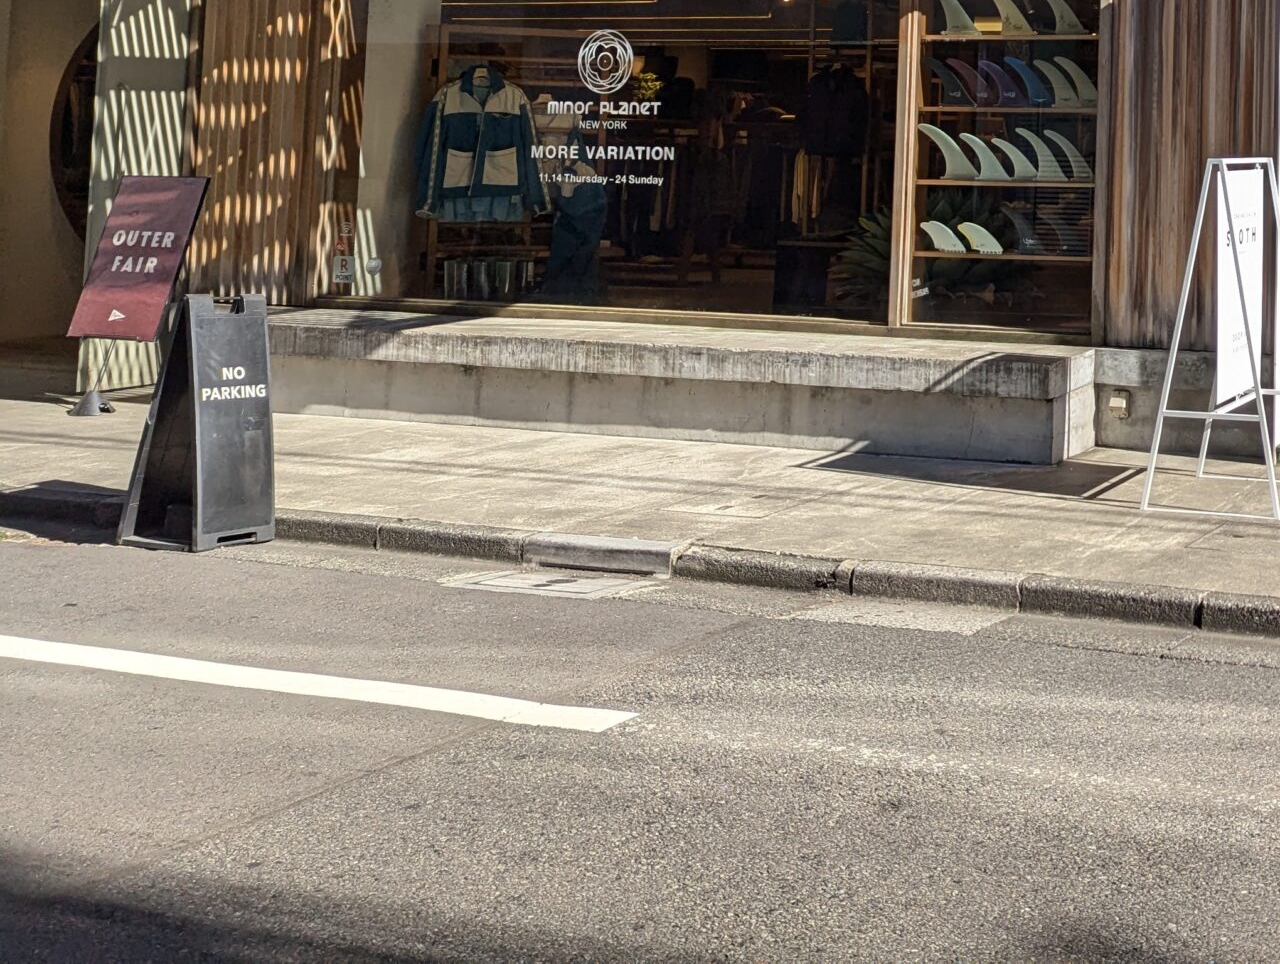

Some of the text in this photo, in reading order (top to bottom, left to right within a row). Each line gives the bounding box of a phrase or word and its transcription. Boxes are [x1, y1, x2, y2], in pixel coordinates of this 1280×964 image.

[579, 120, 628, 130] NEW YORK
[530, 144, 676, 161] MORE VARIATION
[539, 172, 563, 183] 11.14
[564, 173, 609, 185] Thursday
[615, 174, 627, 184] 24
[628, 174, 665, 186] Sunday
[111, 230, 175, 248] OUTER
[1226, 226, 1257, 248] SOTH
[111, 256, 158, 274] FAIR
[221, 366, 246, 381] NO
[201, 383, 266, 402] PARKING
